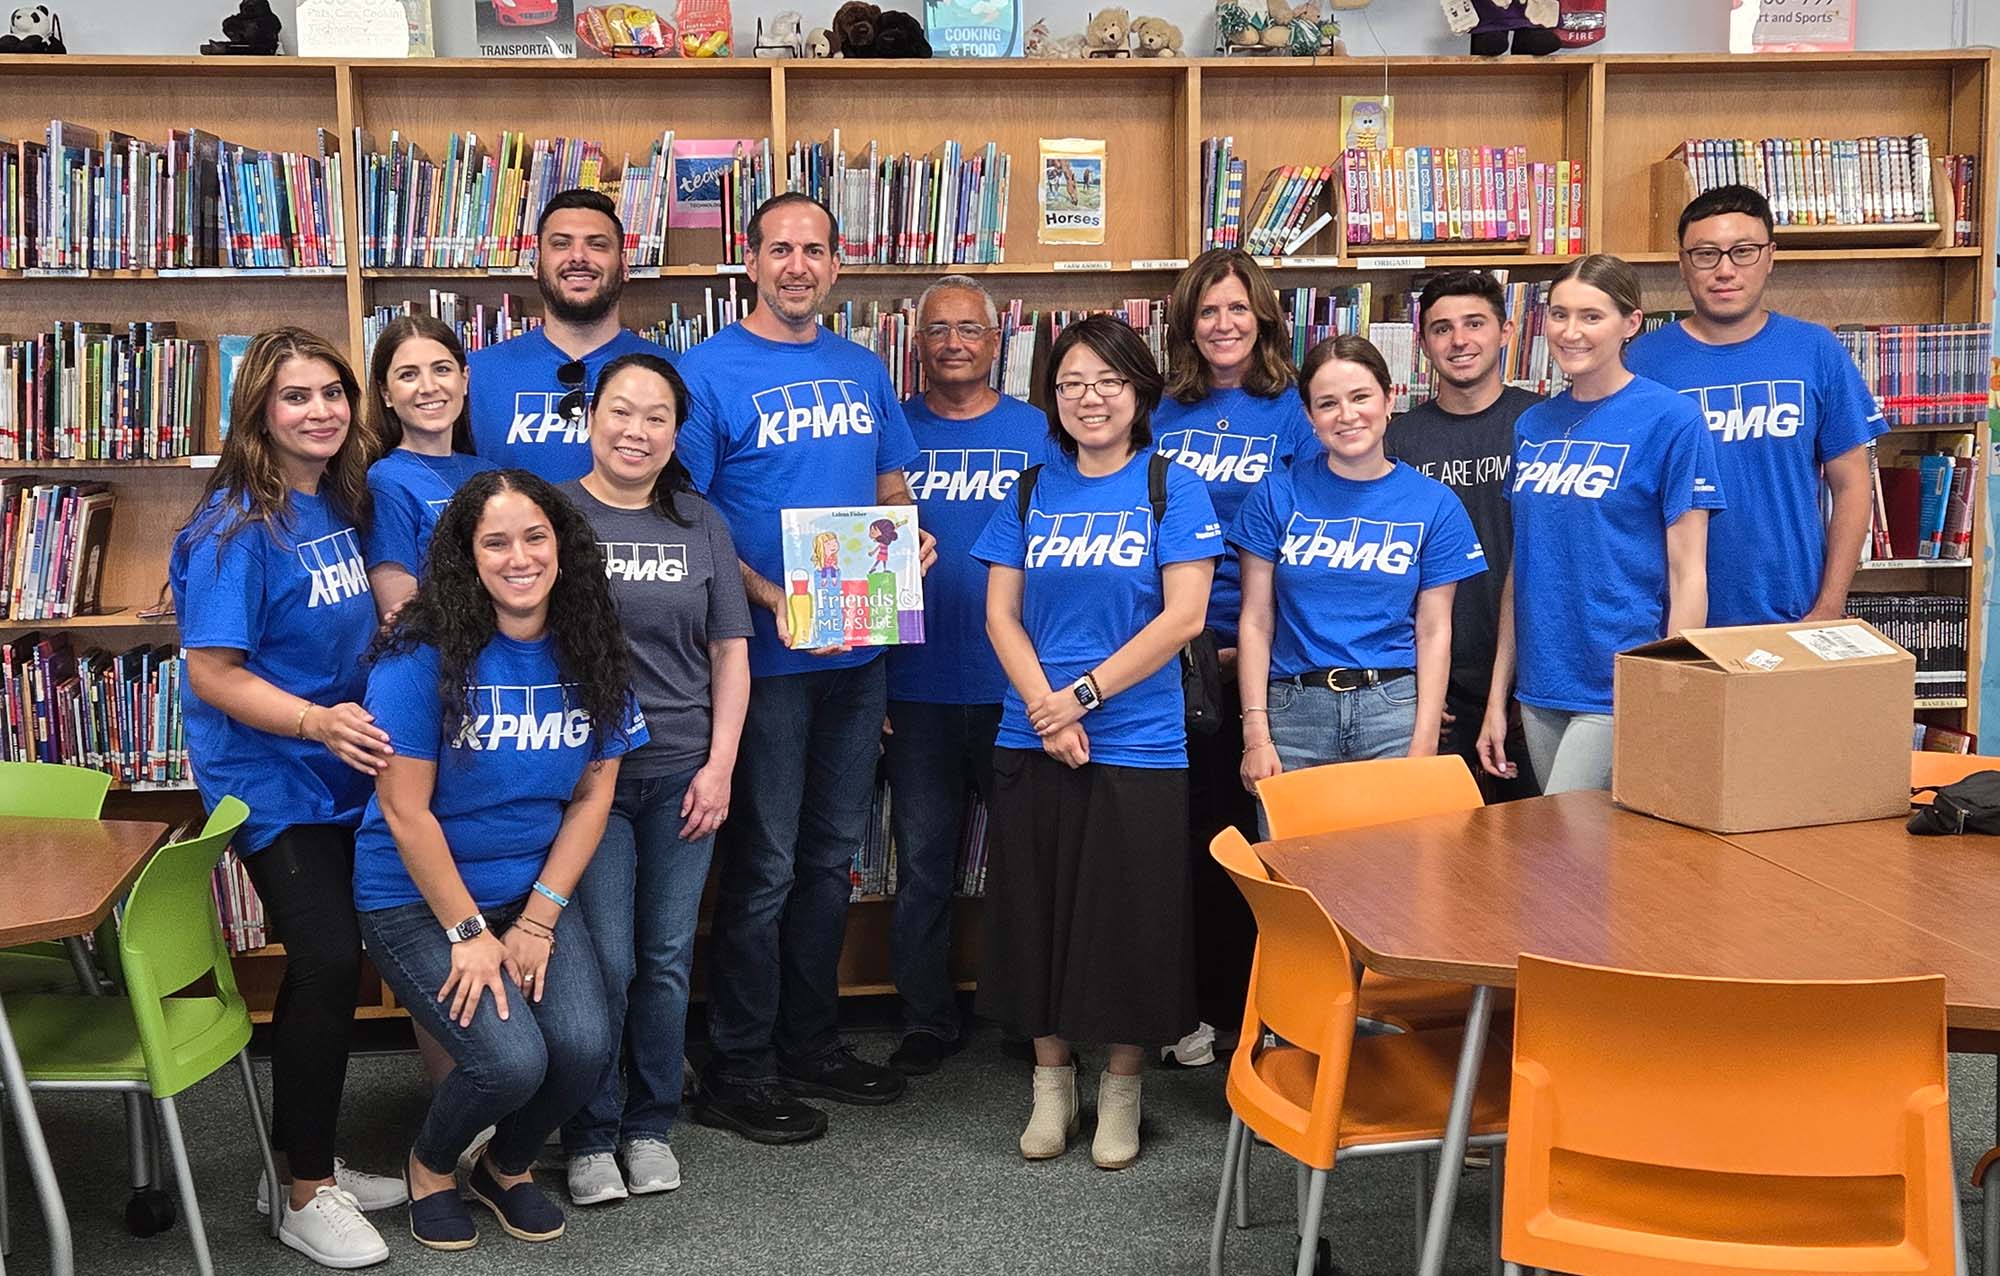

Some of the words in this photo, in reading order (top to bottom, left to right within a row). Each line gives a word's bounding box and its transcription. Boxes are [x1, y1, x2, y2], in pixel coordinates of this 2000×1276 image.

[1758, 13, 1768, 22] rt
[1772, 12, 1792, 23] and
[1795, 12, 1832, 24] Sports
[945, 28, 1000, 41] COOKING
[1568, 32, 1594, 40] FIRE
[950, 45, 959, 56] &
[963, 43, 997, 56] FOOD
[1045, 213, 1100, 226] Horses
[506, 413, 591, 444] KPM
[757, 402, 873, 448] KPMG
[1705, 403, 1800, 441] PMG
[1157, 449, 1268, 482] PMG
[1440, 460, 1473, 486] ARE
[1476, 455, 1511, 484] KPM
[1281, 534, 1414, 575] KPMG
[308, 556, 370, 608] KPM
[602, 558, 684, 582] PMG
[817, 588, 894, 609] Friends
[819, 616, 893, 631] MEASURE
[451, 709, 592, 750] KPMG
